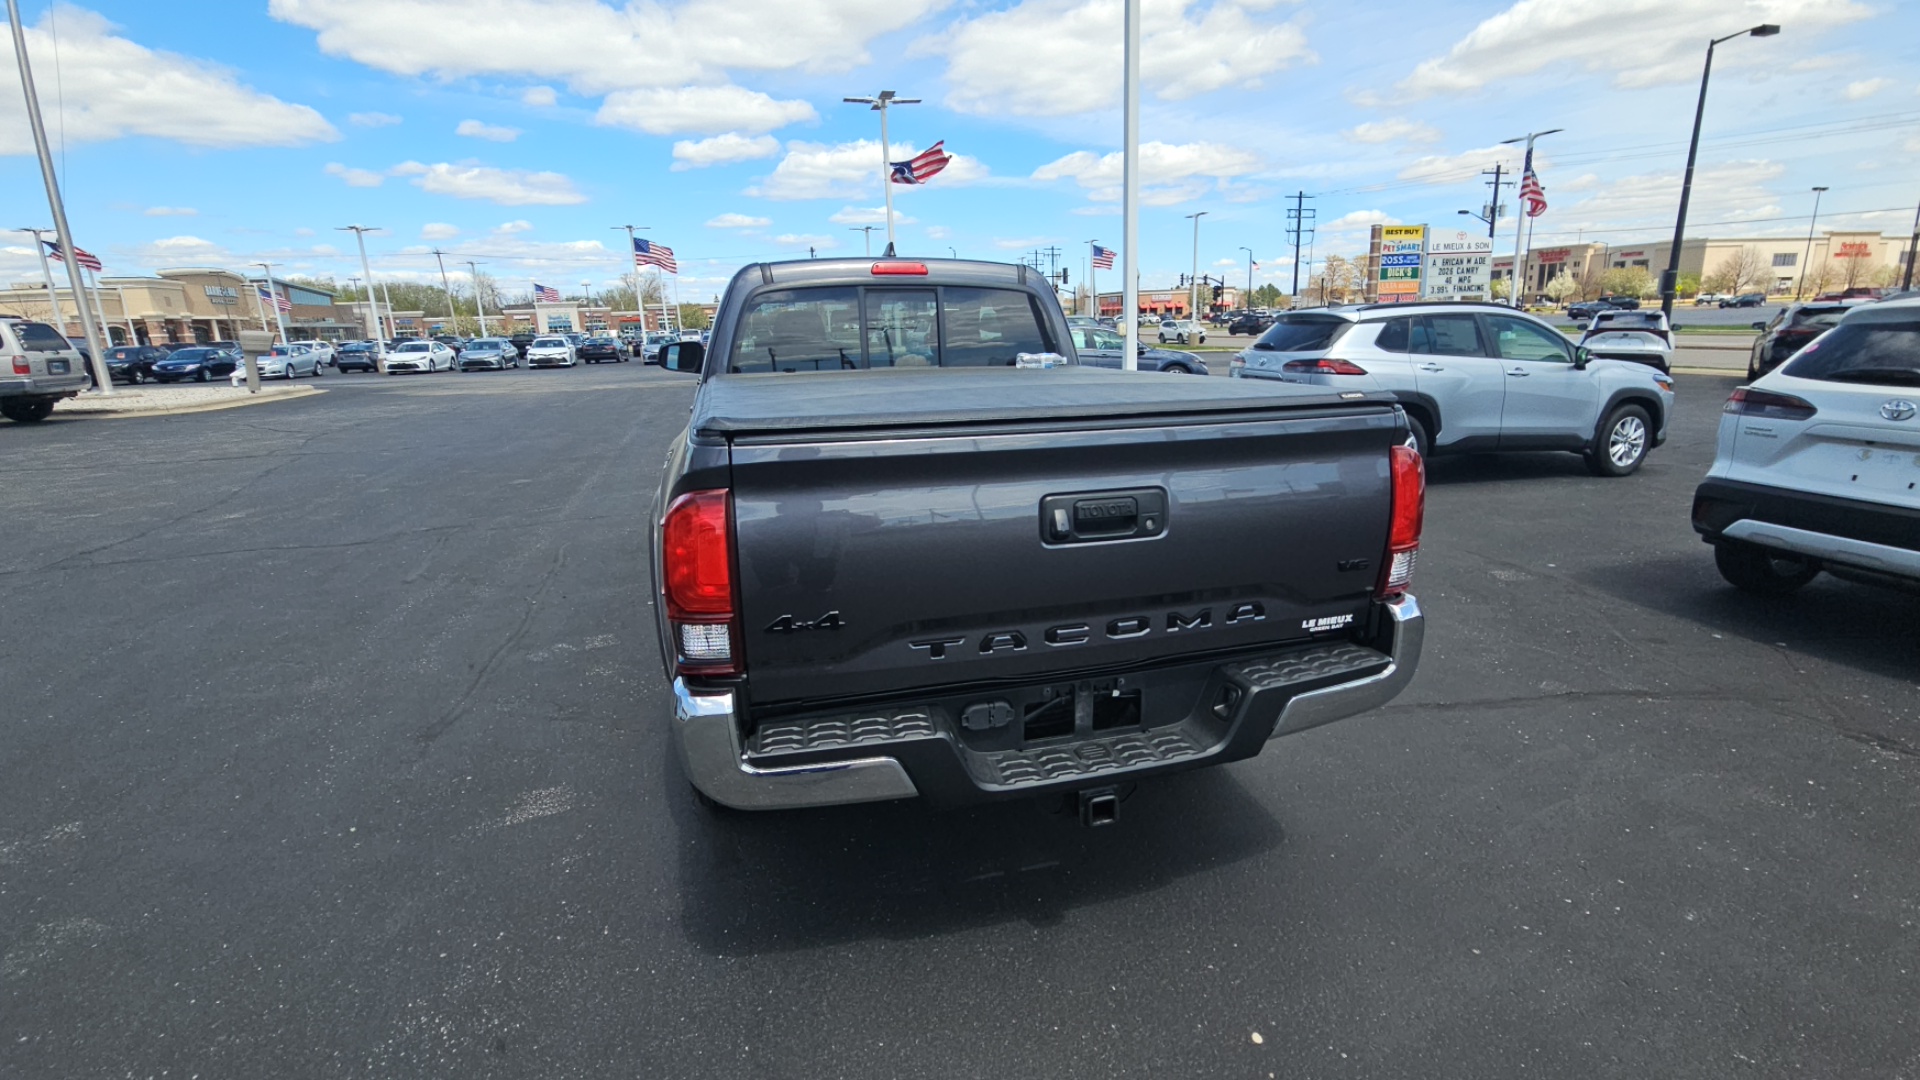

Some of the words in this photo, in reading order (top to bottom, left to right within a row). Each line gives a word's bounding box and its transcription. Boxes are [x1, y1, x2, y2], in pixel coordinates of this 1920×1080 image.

[1432, 243, 1441, 251] LE
[1443, 242, 1464, 251] MIEUX
[1474, 241, 1490, 250] SON
[1456, 266, 1480, 275] CAMRY
[1453, 284, 1485, 293] FINANCING
[1081, 503, 1134, 517] TOYOTA
[1302, 619, 1316, 628] LE
[1317, 614, 1353, 625] MIEUX
[909, 601, 1267, 660] TACOMA
